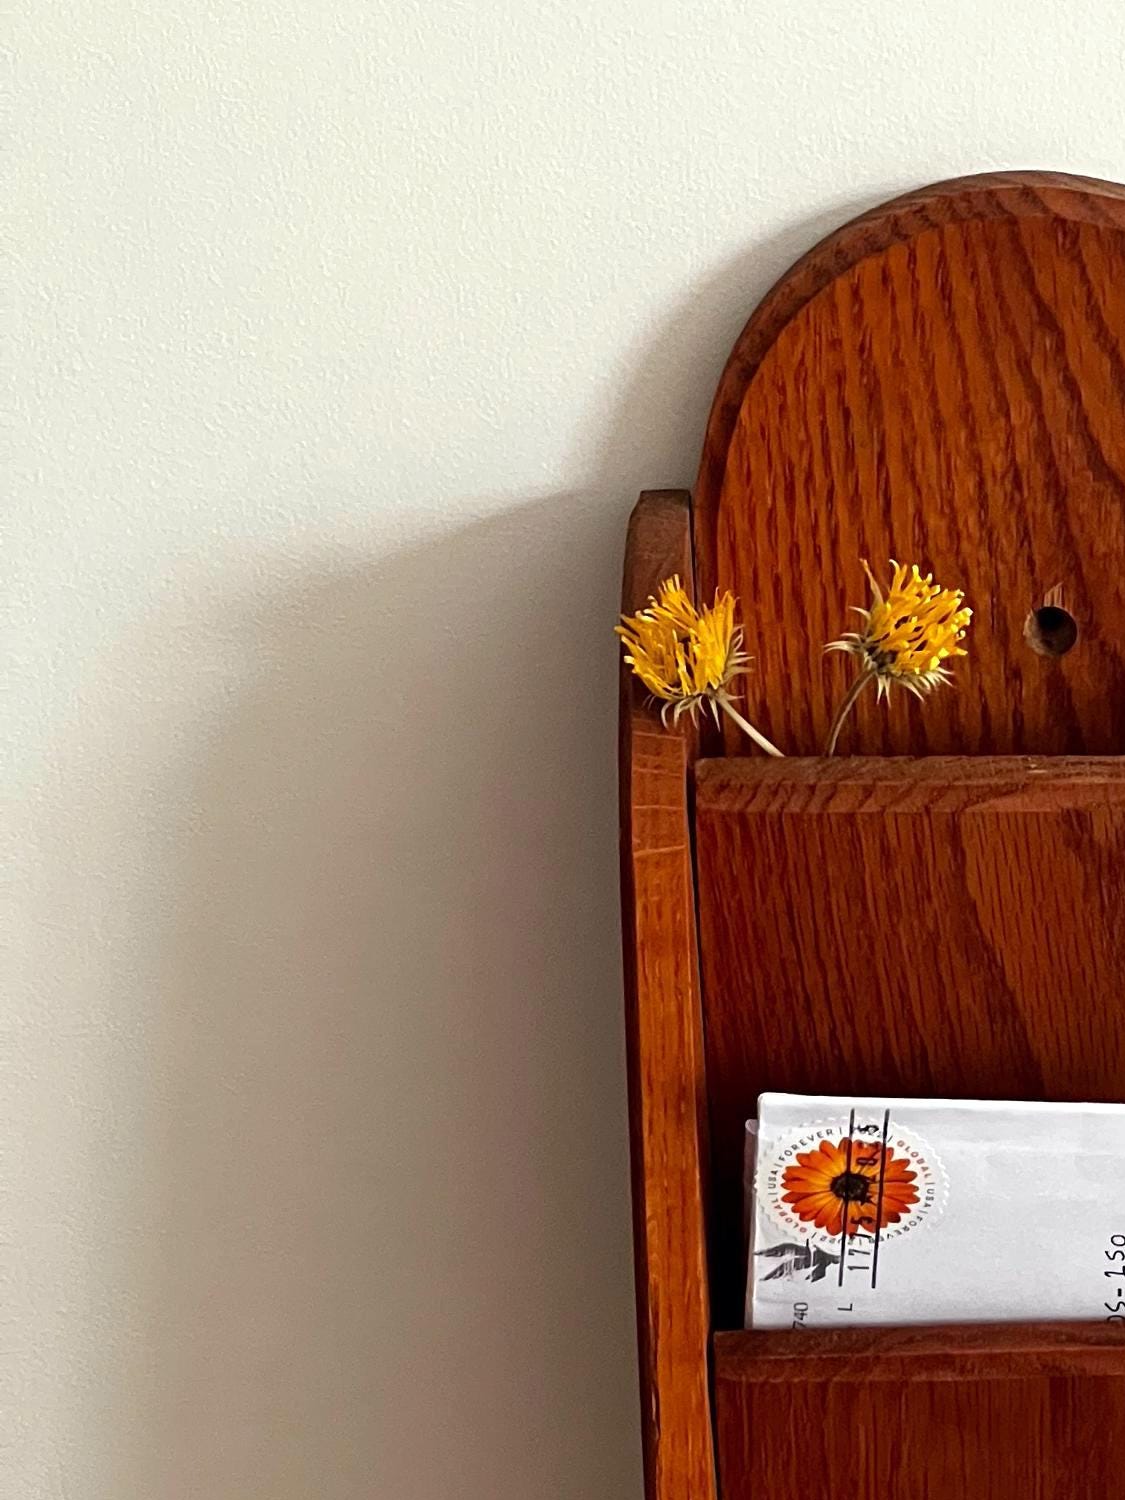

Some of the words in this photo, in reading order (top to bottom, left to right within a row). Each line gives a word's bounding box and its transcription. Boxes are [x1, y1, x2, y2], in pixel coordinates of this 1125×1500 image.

[778, 1128, 834, 1162] FOREVER
[897, 1140, 932, 1179] GLOBAL
[768, 1169, 778, 1190] USA
[924, 1188, 935, 1208] USA
